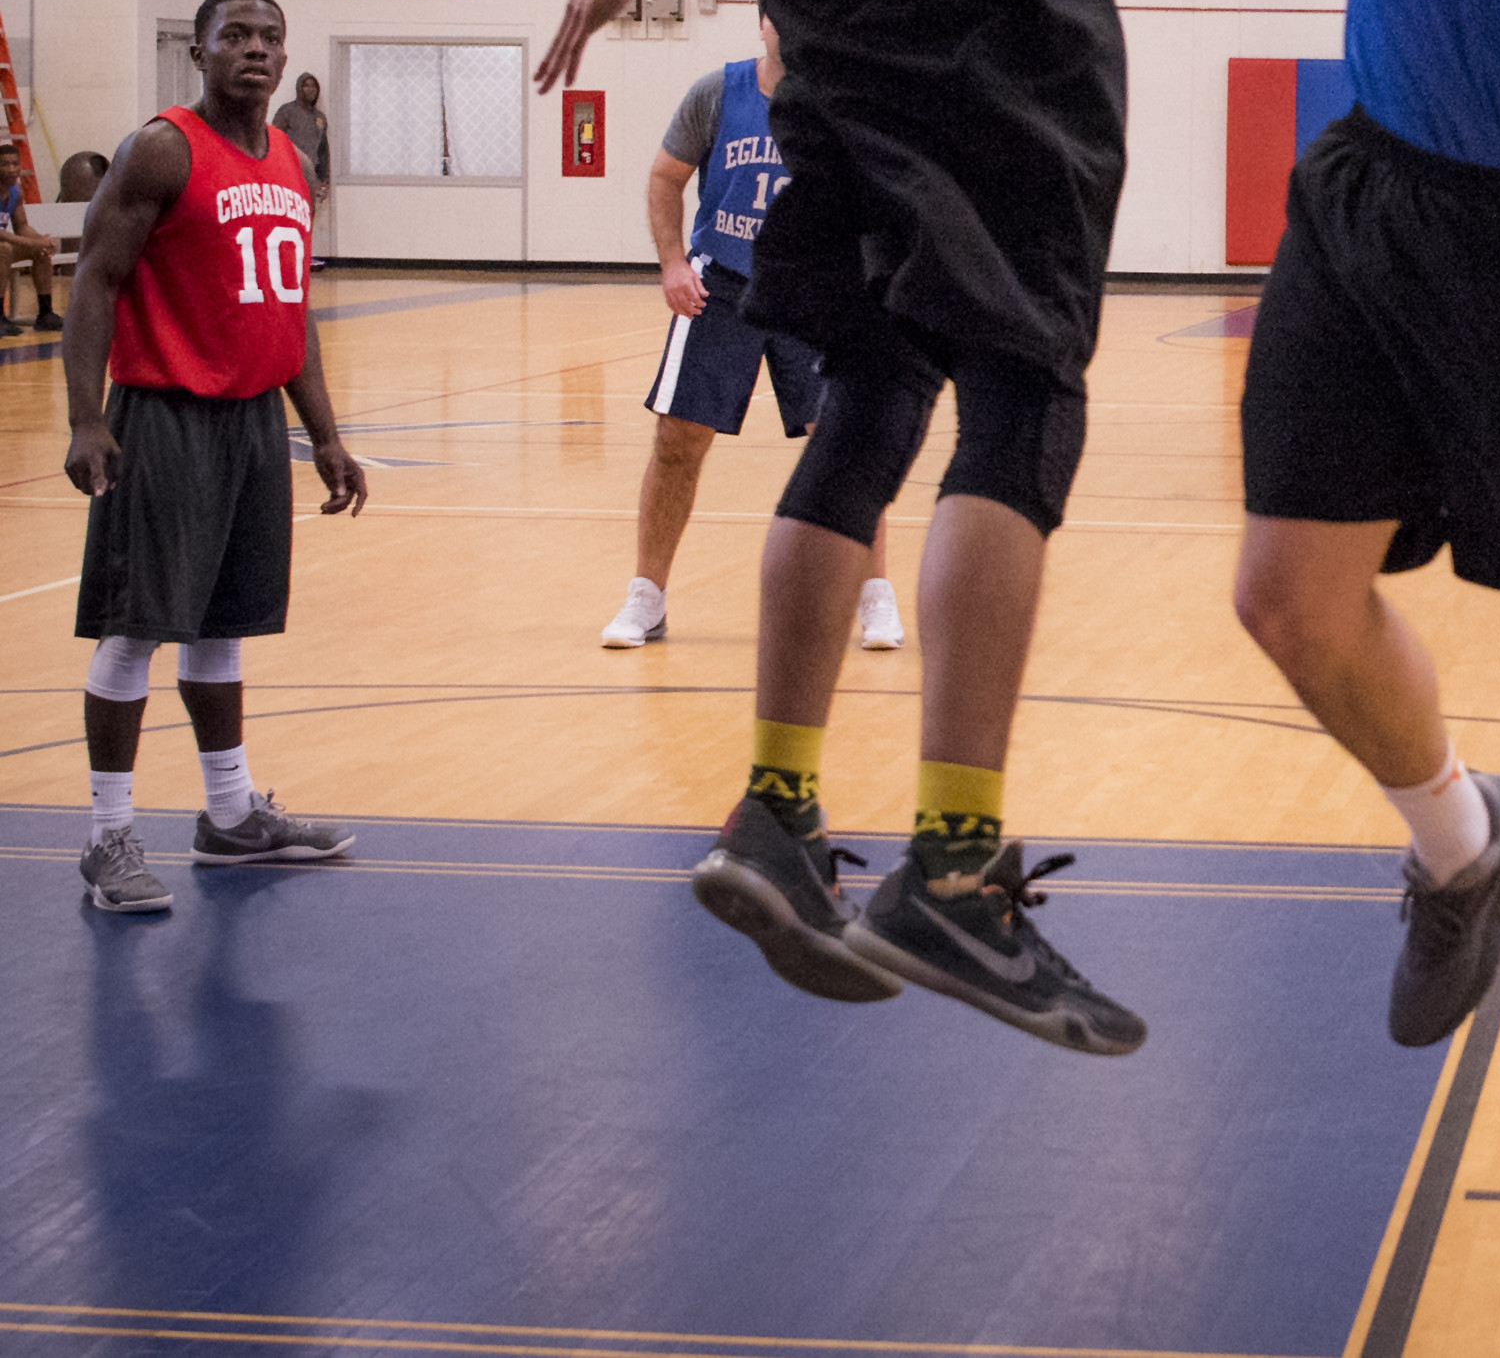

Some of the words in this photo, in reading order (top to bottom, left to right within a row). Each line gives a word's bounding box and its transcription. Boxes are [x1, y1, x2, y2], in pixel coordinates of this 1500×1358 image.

[216, 183, 311, 233] CRUSADERS
[715, 209, 765, 241] BASK
[236, 226, 304, 304] 10
